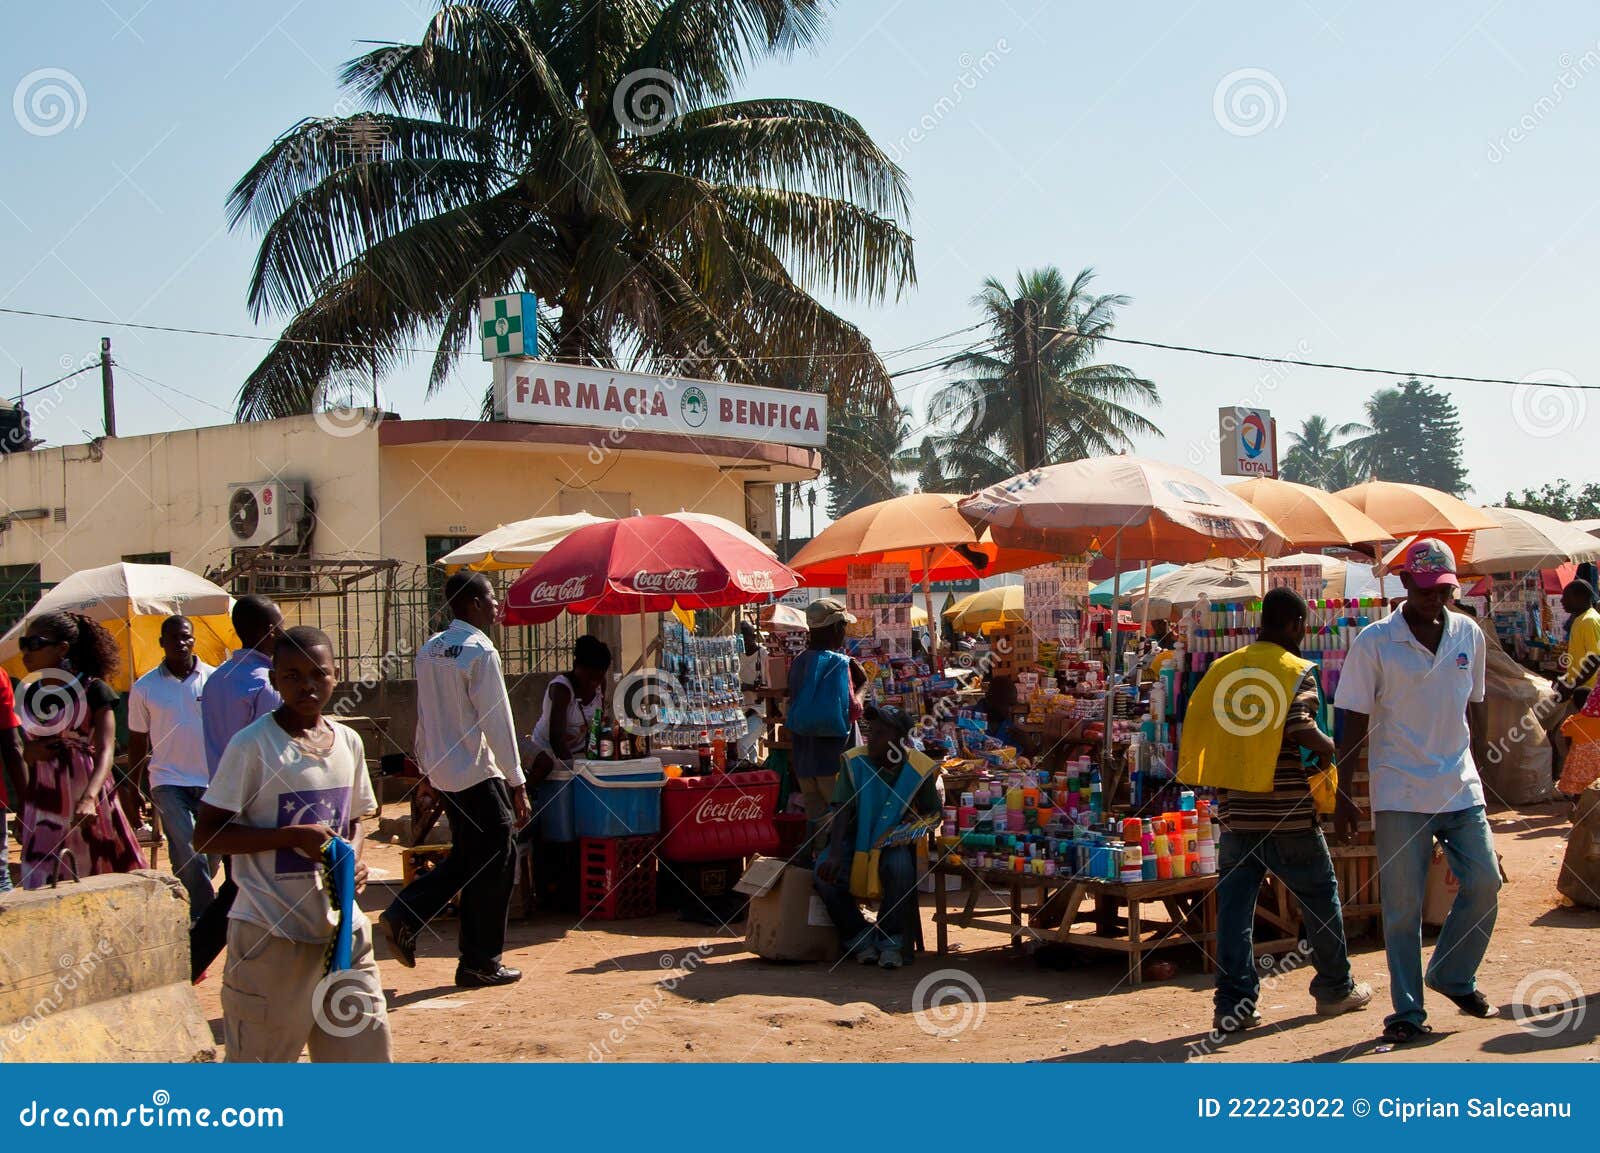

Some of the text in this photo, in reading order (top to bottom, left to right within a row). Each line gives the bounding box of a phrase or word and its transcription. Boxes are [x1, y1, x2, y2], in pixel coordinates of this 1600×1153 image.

[516, 376, 668, 417] FARMÁCIA
[719, 397, 819, 432] BENFICA
[1239, 459, 1271, 473] TOTAL
[264, 507, 272, 515] LG
[531, 575, 592, 603] Coca-Cola
[633, 569, 699, 591] Coca-Cola
[696, 794, 763, 824] Coca-Cola
